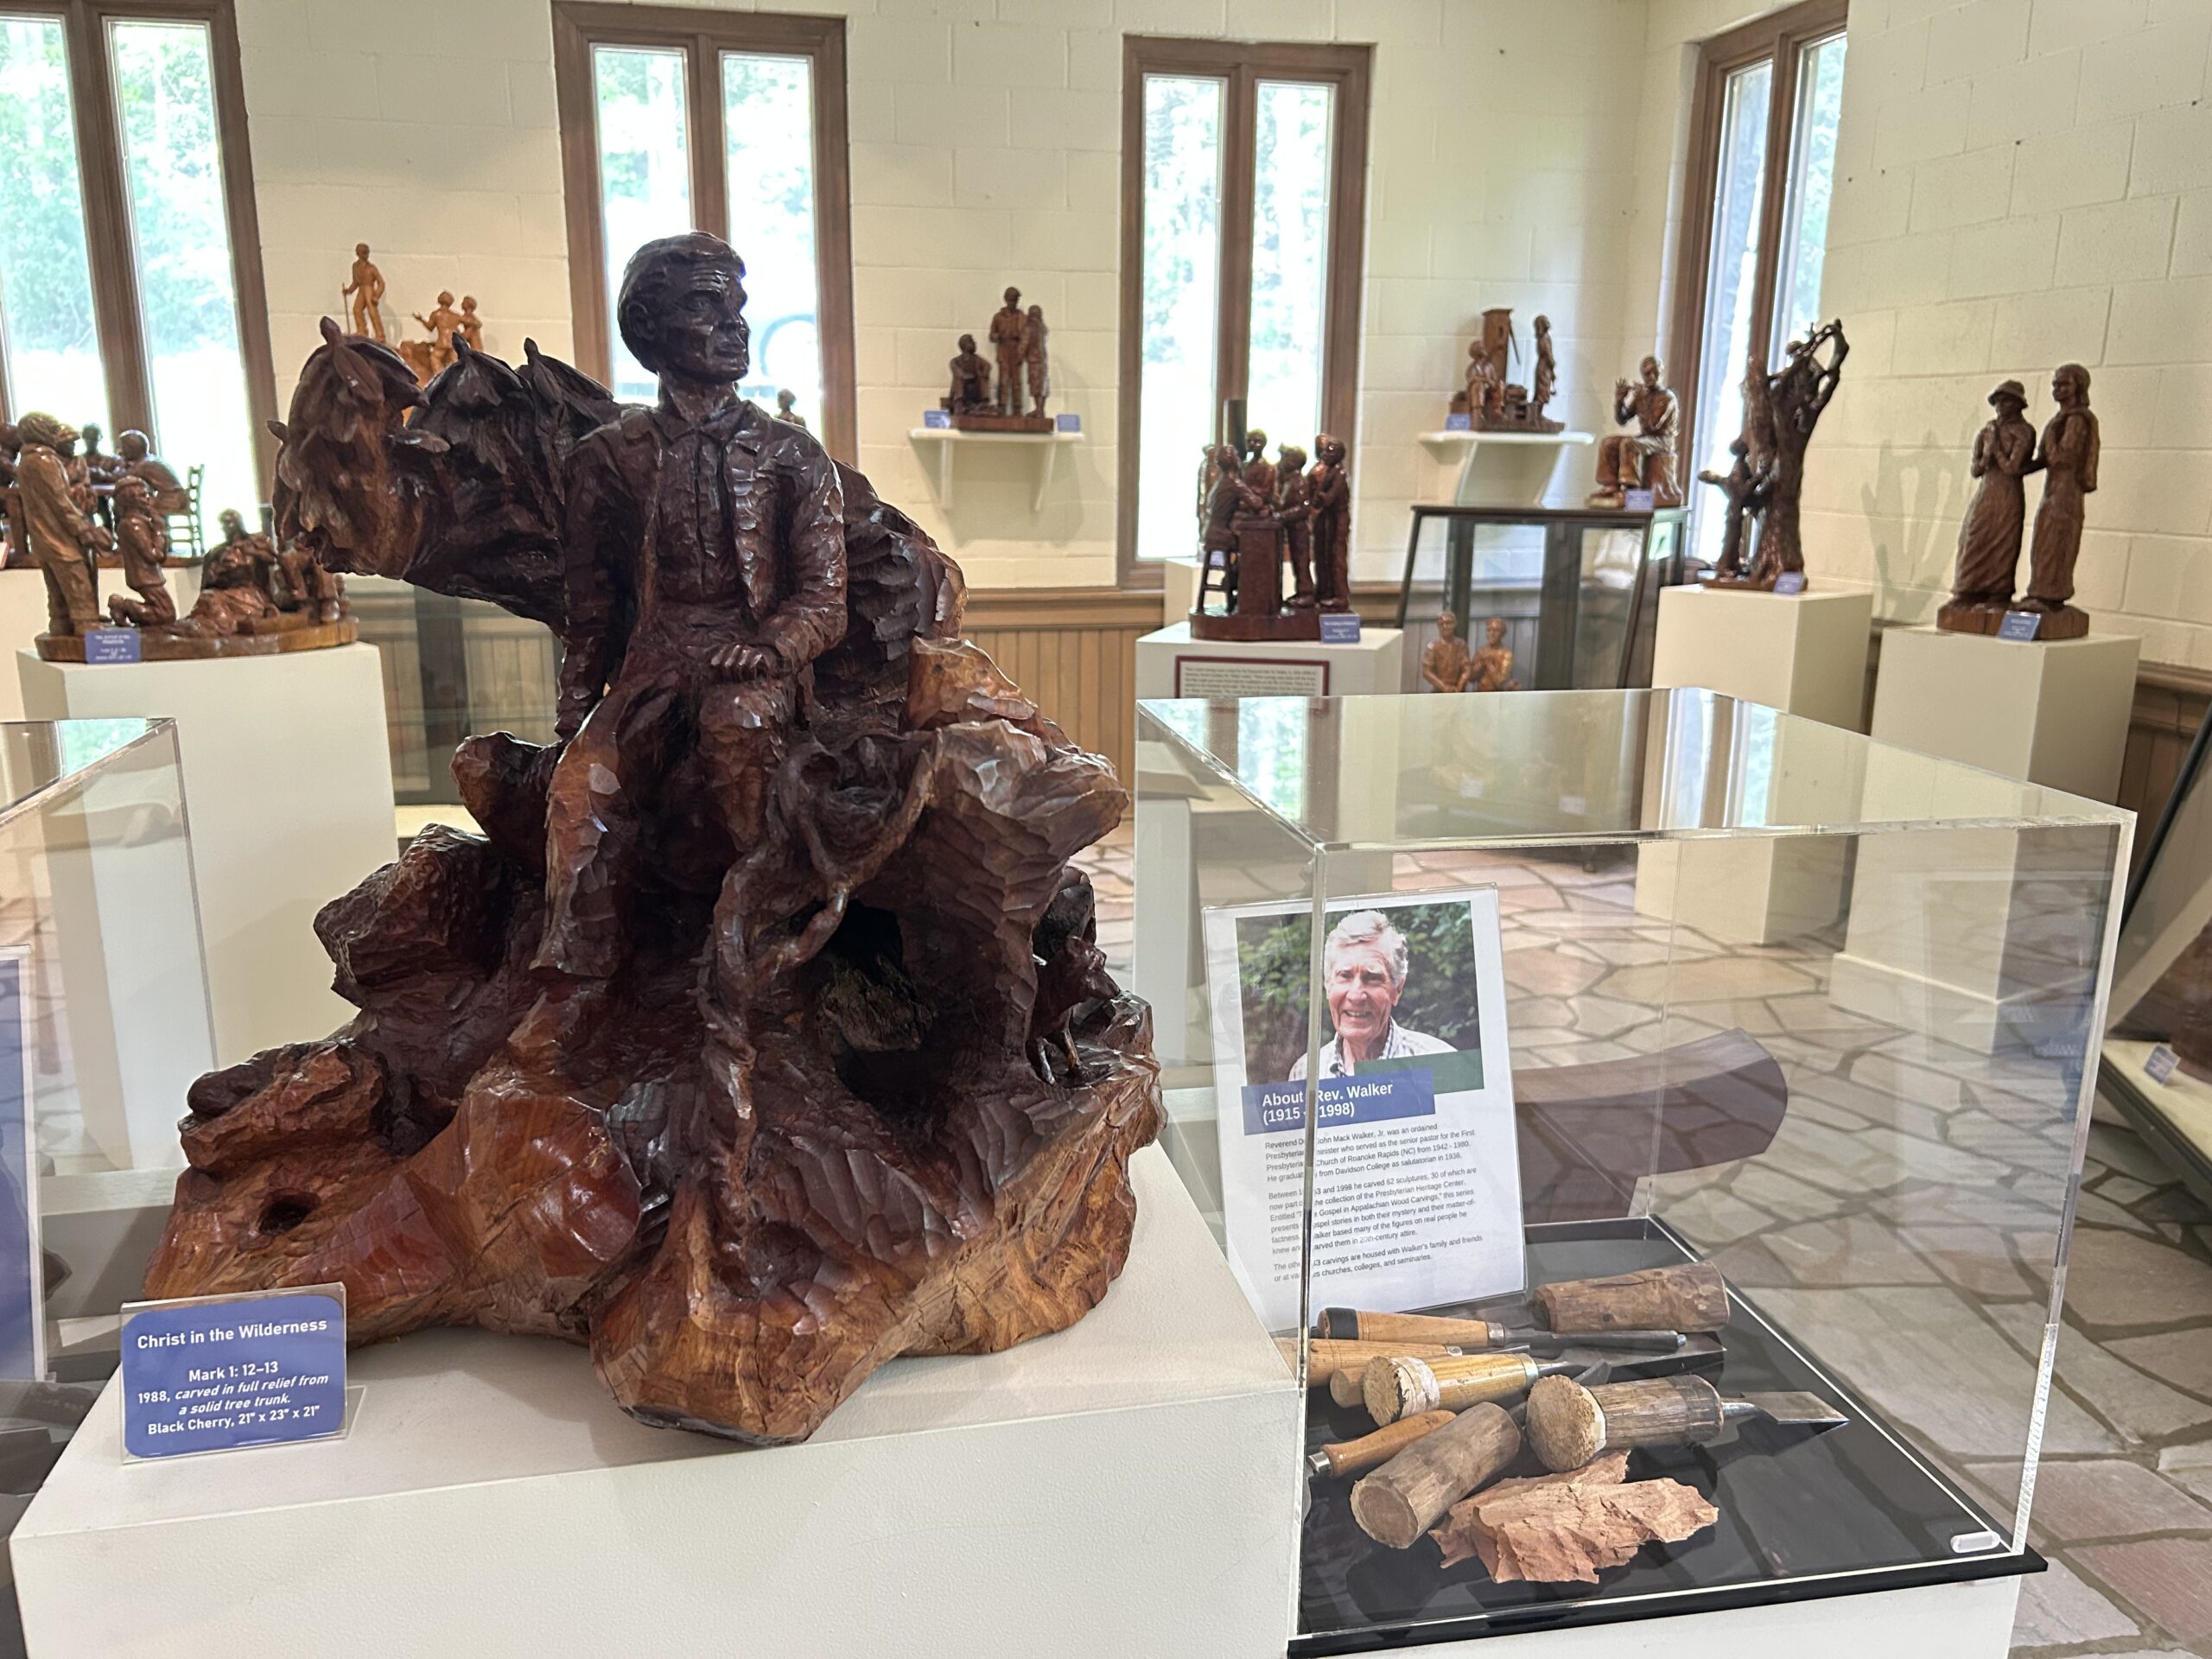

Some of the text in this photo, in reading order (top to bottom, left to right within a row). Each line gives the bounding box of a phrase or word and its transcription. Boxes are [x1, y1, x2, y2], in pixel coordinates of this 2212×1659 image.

[1262, 1090, 1304, 1107] About
[1346, 1083, 1393, 1098] Walker
[1263, 1107, 1300, 1126] (1915
[1319, 1102, 1355, 1118] 1998)
[1265, 1139, 1297, 1149] Reverend
[1333, 1134, 1351, 1142] Mack
[1351, 1131, 1376, 1141] Walker,
[1411, 1123, 1438, 1133] ordained
[1355, 1141, 1376, 1151] served
[1400, 1136, 1418, 1145] senior
[1420, 1134, 1439, 1144] pastor
[1450, 1130, 1460, 1139] the
[1267, 1161, 1303, 1171] Presbyteria
[1348, 1153, 1376, 1163] Roanoke
[1377, 1149, 1400, 1160] Rapids
[1401, 1147, 1416, 1157] (NC)
[1336, 1165, 1365, 1175] Davidson
[1367, 1163, 1389, 1172] College
[1402, 1156, 1436, 1166] salutatorian
[1268, 1190, 1297, 1199] Between
[1363, 1179, 1384, 1189] carved
[1396, 1174, 1429, 1184] sculptures,
[1447, 1168, 1465, 1177] which
[1285, 1201, 1298, 1210] part
[1325, 1194, 1355, 1205] collection
[1357, 1192, 1363, 1201] of
[1363, 1191, 1374, 1199] the
[1376, 1187, 1414, 1198] Presbyterian
[1416, 1183, 1441, 1193] Heritage
[1270, 1212, 1295, 1222] Entitled
[1319, 1208, 1341, 1217] Gospel
[1351, 1201, 1389, 1212] Appalachian
[1391, 1198, 1410, 1206] Wood
[1271, 1224, 1300, 1234] presents
[1331, 1217, 1352, 1225] stories
[1392, 1208, 1415, 1217] mystery
[1431, 1203, 1445, 1211] their
[1314, 1230, 1331, 1239] alker
[1332, 1227, 1352, 1236] based
[1392, 1218, 1414, 1229] figures
[1437, 1212, 1458, 1222] people
[1322, 1255, 1349, 1265] carvings
[1363, 1249, 1386, 1259] housed
[1429, 1241, 1447, 1249] family
[1462, 1235, 1483, 1243] friends
[1334, 1239, 1351, 1248] them
[1322, 1267, 1353, 1276] churches,
[1354, 1262, 1382, 1272] colleges,
[137, 1319, 327, 1349] Christ in the Wilderness
[188, 1367, 226, 1382] Mark
[229, 1365, 238, 1377] 1:
[138, 1374, 329, 1404] 1988, carved in full relief from
[178, 1393, 291, 1415] a solid tree trunk.
[148, 1421, 185, 1435] Black
[188, 1415, 235, 1431] Cherry,
[258, 1414, 266, 1422] x
[292, 1410, 300, 1419] x
